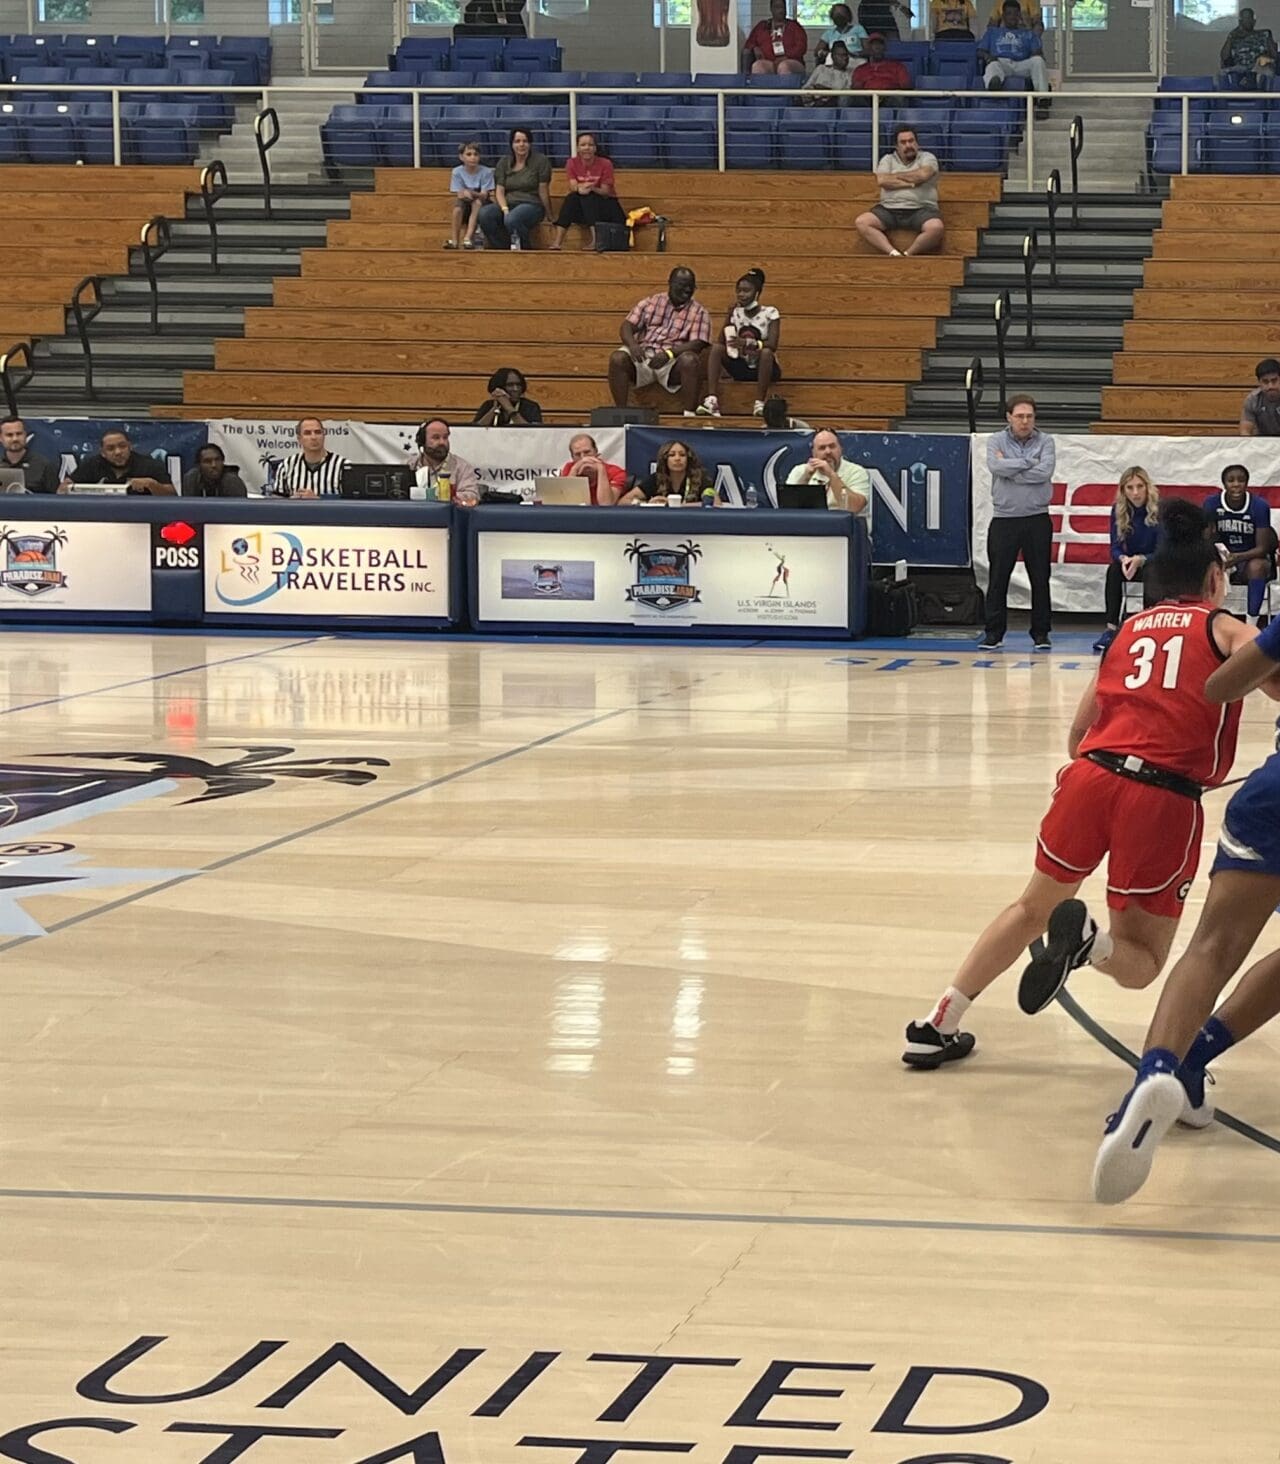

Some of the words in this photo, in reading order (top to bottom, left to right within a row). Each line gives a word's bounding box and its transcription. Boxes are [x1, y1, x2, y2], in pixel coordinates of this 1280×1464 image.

[222, 424, 243, 434] The
[488, 468, 542, 481] VIRGIN
[1217, 519, 1255, 534] PIRATES
[156, 546, 199, 568] POSS
[271, 547, 428, 569] BASKETBALL
[3, 571, 43, 583] PARADISE
[271, 571, 406, 592] TRAVELERS
[410, 582, 436, 593] INC.
[633, 586, 676, 597] PARADISE
[753, 600, 782, 608] VIRGIN
[783, 600, 817, 608] ISLANDS
[1132, 612, 1193, 633] WARREN
[1123, 635, 1184, 690] 31
[73, 1335, 1051, 1434] UNITED
